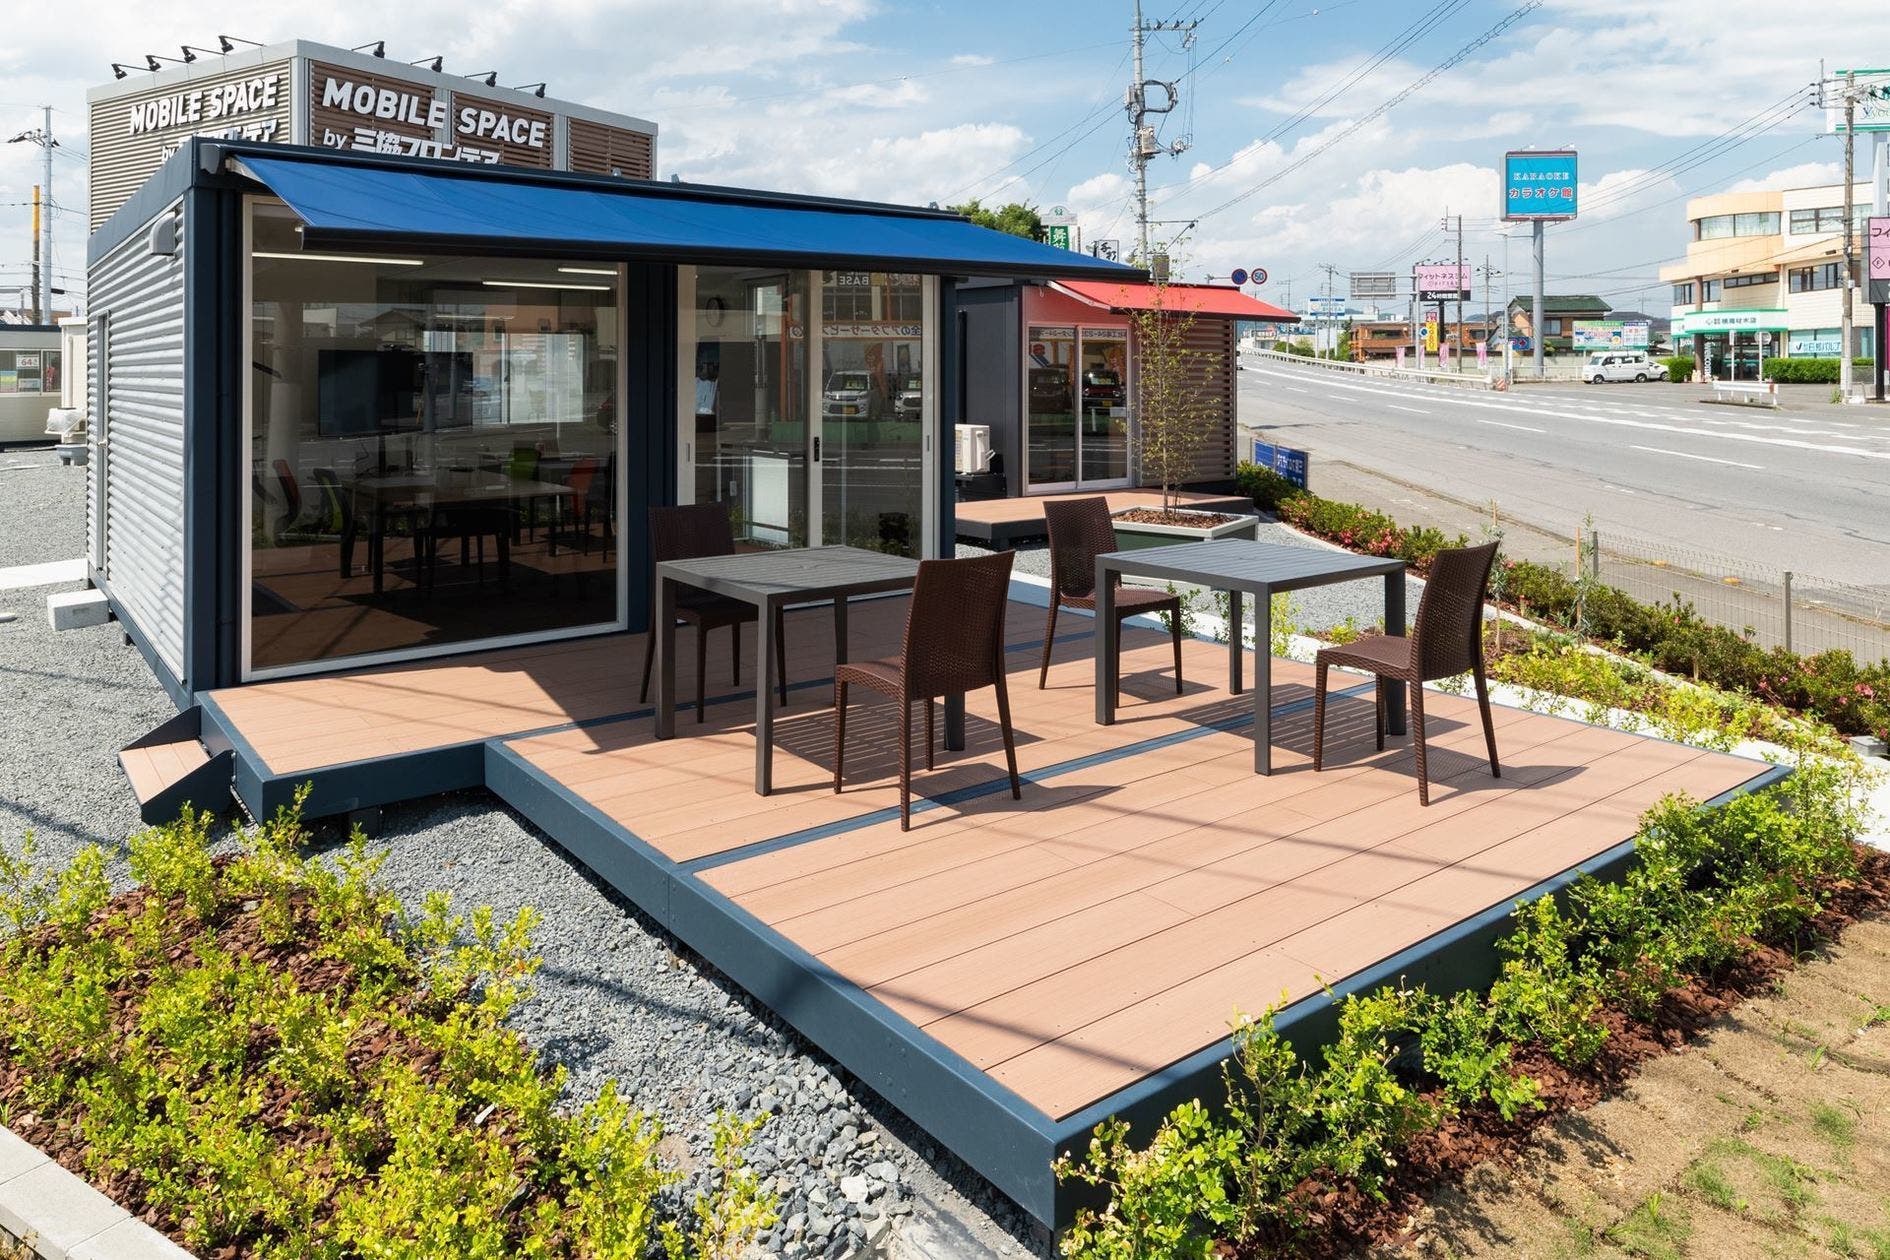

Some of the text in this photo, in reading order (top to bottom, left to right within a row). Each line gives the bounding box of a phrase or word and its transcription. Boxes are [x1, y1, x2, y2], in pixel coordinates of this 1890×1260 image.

[129, 74, 279, 136] MOBILE SPACE
[322, 77, 547, 148] MOBILE SPACE
[323, 127, 500, 165] by 三協フロンテア
[1513, 172, 1569, 181] KARAOKE
[1509, 187, 1573, 199] カラオケ館
[1254, 271, 1265, 281] 50
